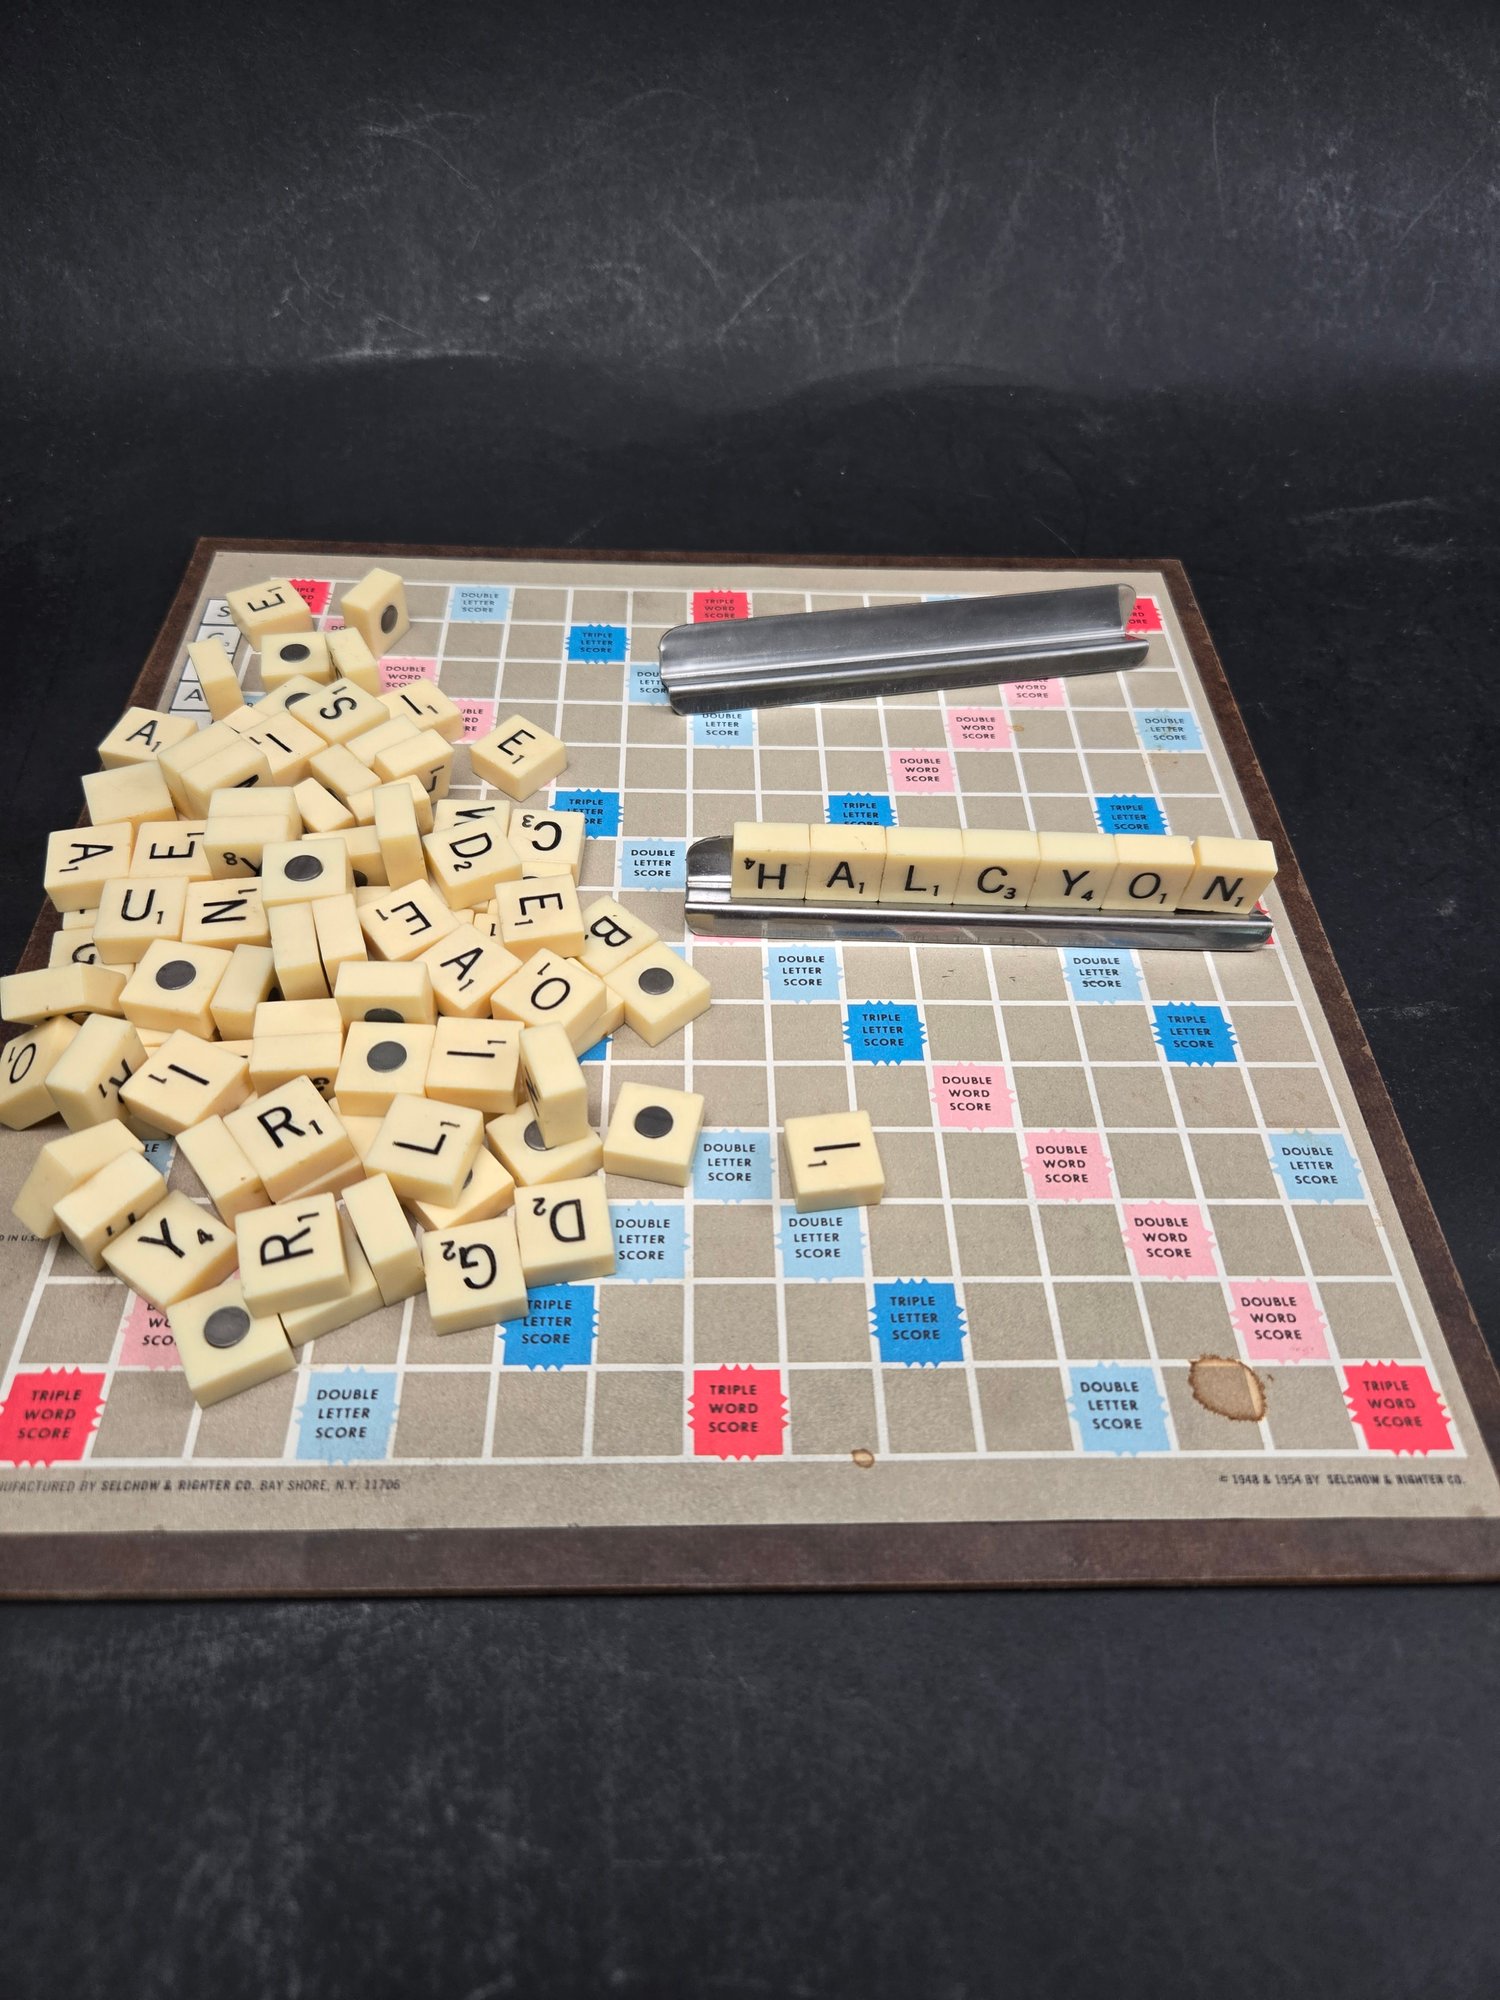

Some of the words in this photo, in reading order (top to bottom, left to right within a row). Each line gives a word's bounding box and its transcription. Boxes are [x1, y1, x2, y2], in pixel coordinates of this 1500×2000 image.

[631, 849, 675, 858] DOUBLE
[634, 869, 671, 877] SCORE
[1074, 957, 1120, 965] DOUBLE
[782, 967, 822, 975] LETTER
[1083, 980, 1122, 988] SCORE
[863, 1026, 903, 1034] LETTER
[1170, 1028, 1211, 1036] LETTER
[864, 1038, 905, 1046] SCORE
[1173, 1040, 1215, 1048] SCORE
[942, 1076, 993, 1085] DOUBLE
[948, 1089, 990, 1098] WORD
[949, 1102, 992, 1111] SCORE
[703, 1143, 756, 1153] DOUBLE
[1036, 1145, 1088, 1155] DOUBLE
[1281, 1147, 1334, 1156] DOUBLE
[707, 1157, 752, 1167] LETTER
[1042, 1159, 1086, 1169] WORD
[1289, 1161, 1334, 1170] LETTER
[708, 1172, 752, 1182] SCORE
[1045, 1173, 1089, 1183] SCORE
[1295, 1175, 1338, 1185] SCORE
[615, 1219, 671, 1229] DOUBLE
[789, 1217, 843, 1227] DOUBLE
[1134, 1217, 1189, 1228] DOUBLE
[619, 1234, 665, 1244] LETTER
[794, 1233, 840, 1243] LETTER
[1142, 1232, 1188, 1243] WORD
[619, 1250, 665, 1260] SCORE
[795, 1248, 841, 1258] SCORE
[1146, 1248, 1192, 1258] SCORE
[528, 1300, 572, 1310] TRIPLE
[890, 1296, 936, 1307] TRIPLE
[1241, 1297, 1297, 1307] DOUBLE
[523, 1317, 572, 1326] LETTER
[890, 1313, 938, 1323] LETTER
[1249, 1313, 1297, 1323] WORD
[522, 1334, 571, 1344] SCORE
[892, 1329, 941, 1340] SCORE
[1254, 1329, 1302, 1340] SCORE
[142, 1335, 176, 1346] SCO
[710, 1385, 757, 1396] TRIPLE
[1080, 1382, 1140, 1393] DOUBLE
[1362, 1380, 1409, 1391] TRIPLE
[31, 1390, 82, 1401] TRIPLE
[317, 1389, 379, 1400] DOUBLE
[709, 1403, 758, 1414] WORD
[1088, 1400, 1138, 1411] LETTER
[1367, 1398, 1415, 1409] WORD
[24, 1409, 76, 1420] WORD
[318, 1408, 371, 1419] LETTER
[1092, 1419, 1143, 1430] SCORE
[1373, 1416, 1422, 1427] SCORE
[709, 1421, 760, 1433] SCORE
[18, 1428, 71, 1440] SCORE
[315, 1427, 367, 1438] SCORE
